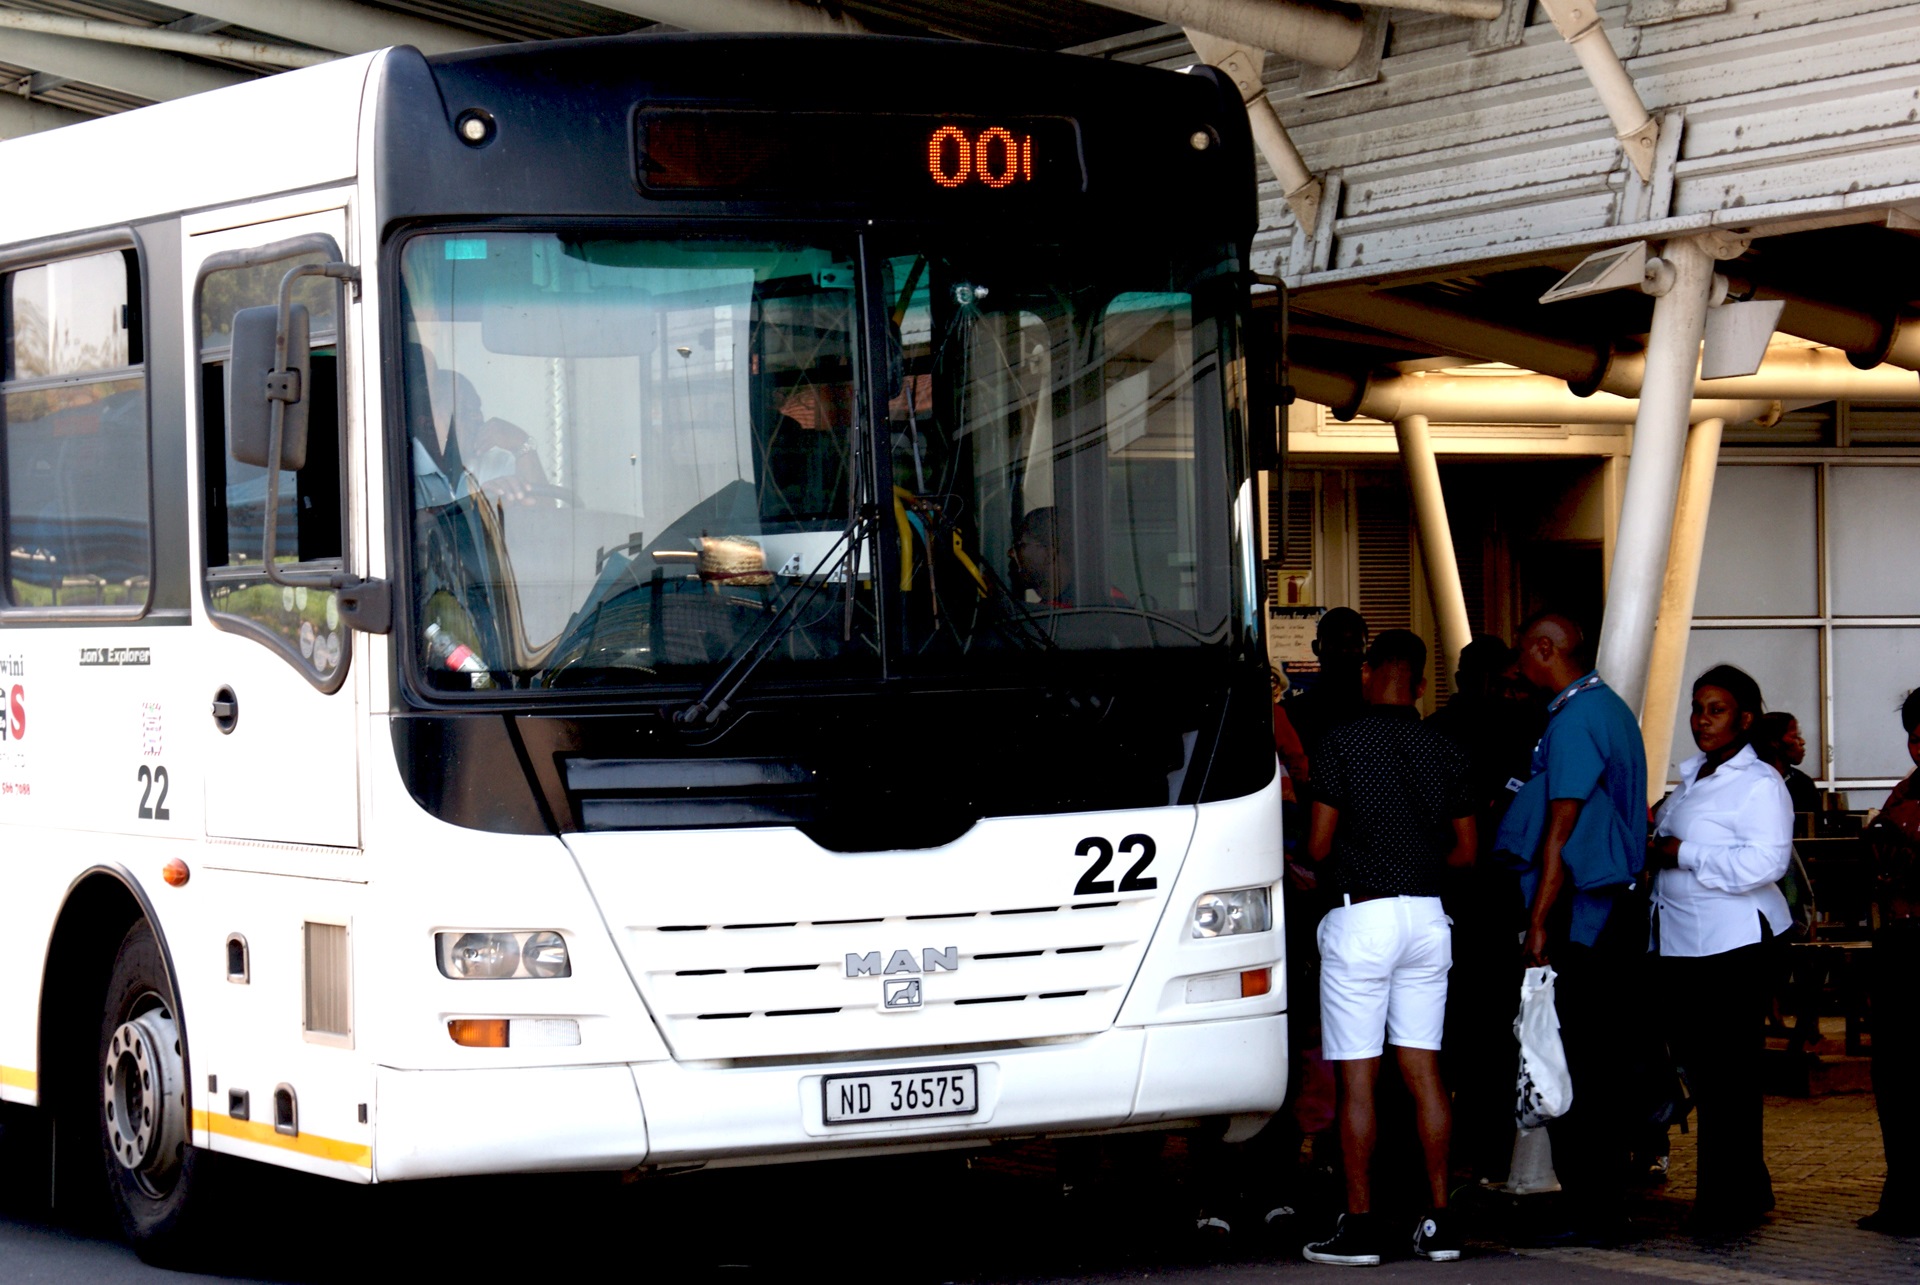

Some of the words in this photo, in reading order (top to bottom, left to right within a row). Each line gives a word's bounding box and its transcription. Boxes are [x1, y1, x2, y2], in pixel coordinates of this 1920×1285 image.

[107, 647, 151, 665] Explorer
[137, 764, 170, 821] 22
[1073, 833, 1158, 896] 22
[845, 946, 958, 978] MAN
[841, 1083, 871, 1115] ND
[890, 1075, 964, 1112] 36575
